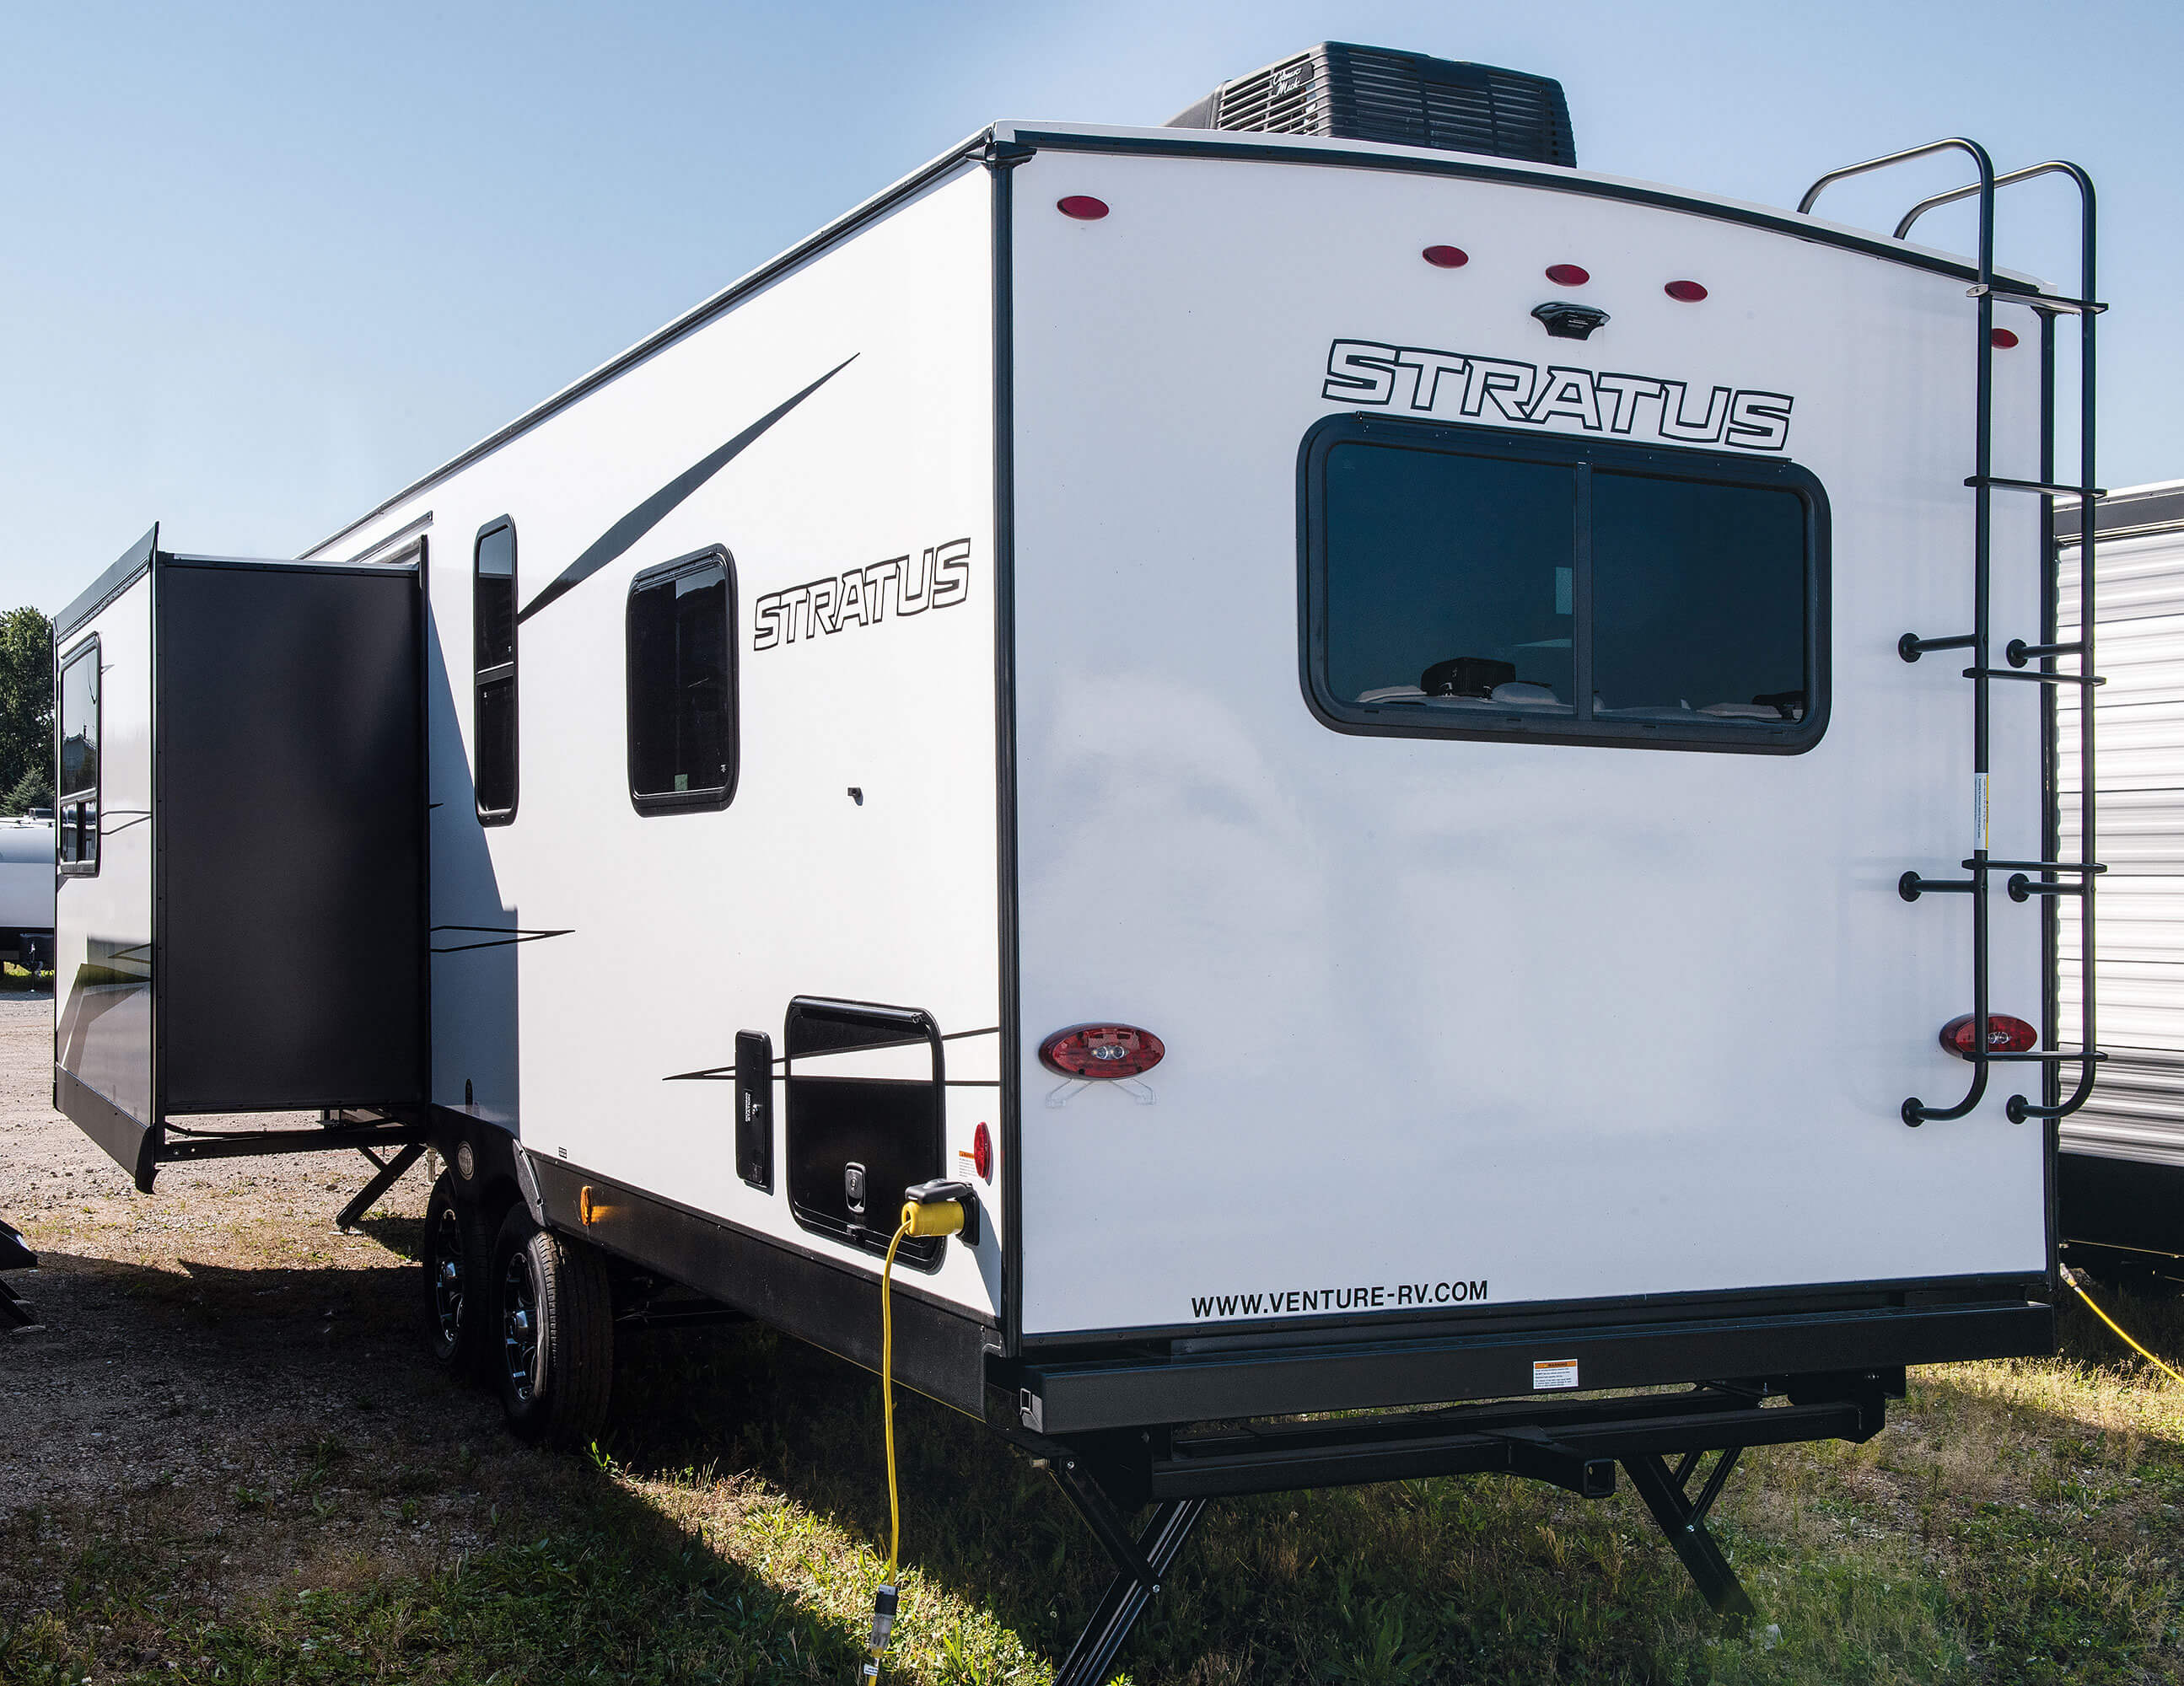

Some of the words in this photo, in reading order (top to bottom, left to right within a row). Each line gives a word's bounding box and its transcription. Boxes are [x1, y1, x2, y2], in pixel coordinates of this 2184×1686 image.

[1321, 338, 1794, 451] STRATUS
[753, 537, 971, 652] STRATUS
[1191, 1280, 1488, 1318] WWW.VENTURE-RV.COM
